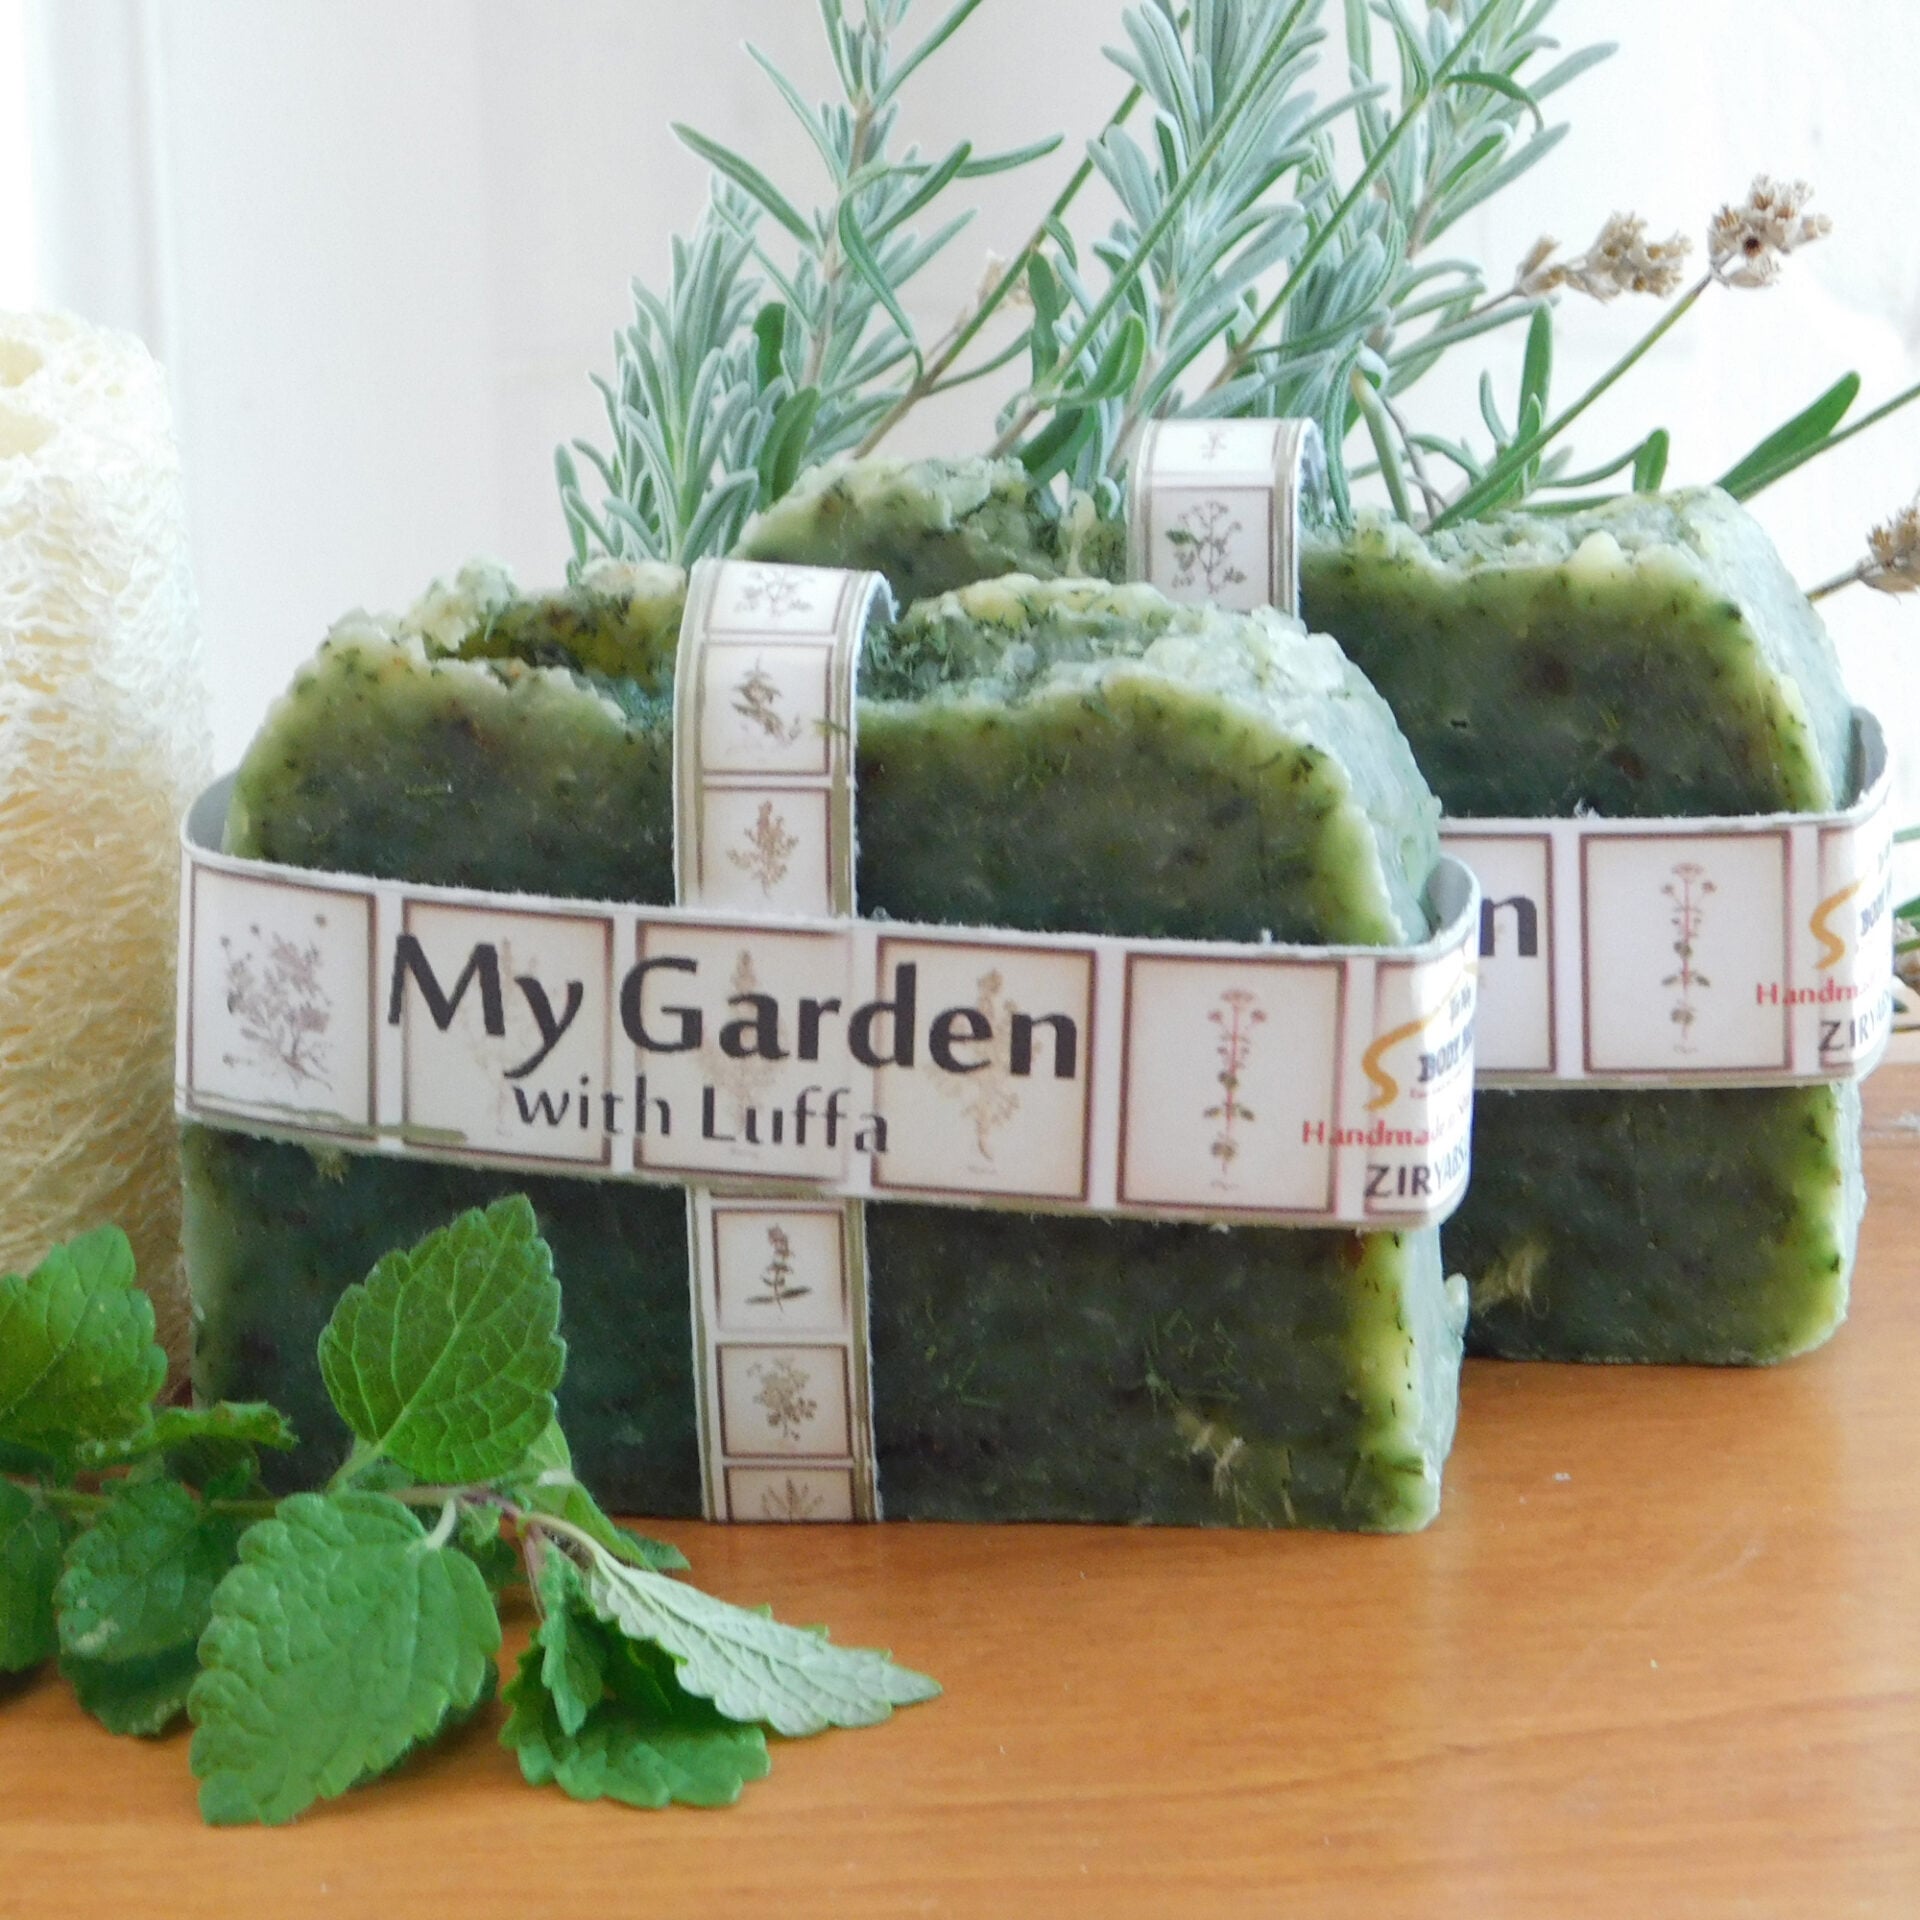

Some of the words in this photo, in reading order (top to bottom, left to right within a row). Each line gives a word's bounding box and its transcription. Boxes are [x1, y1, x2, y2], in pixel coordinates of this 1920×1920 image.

[387, 933, 585, 1080] My
[619, 954, 1079, 1081] Garden
[512, 1074, 672, 1139] with
[702, 1086, 890, 1155] Luffa
